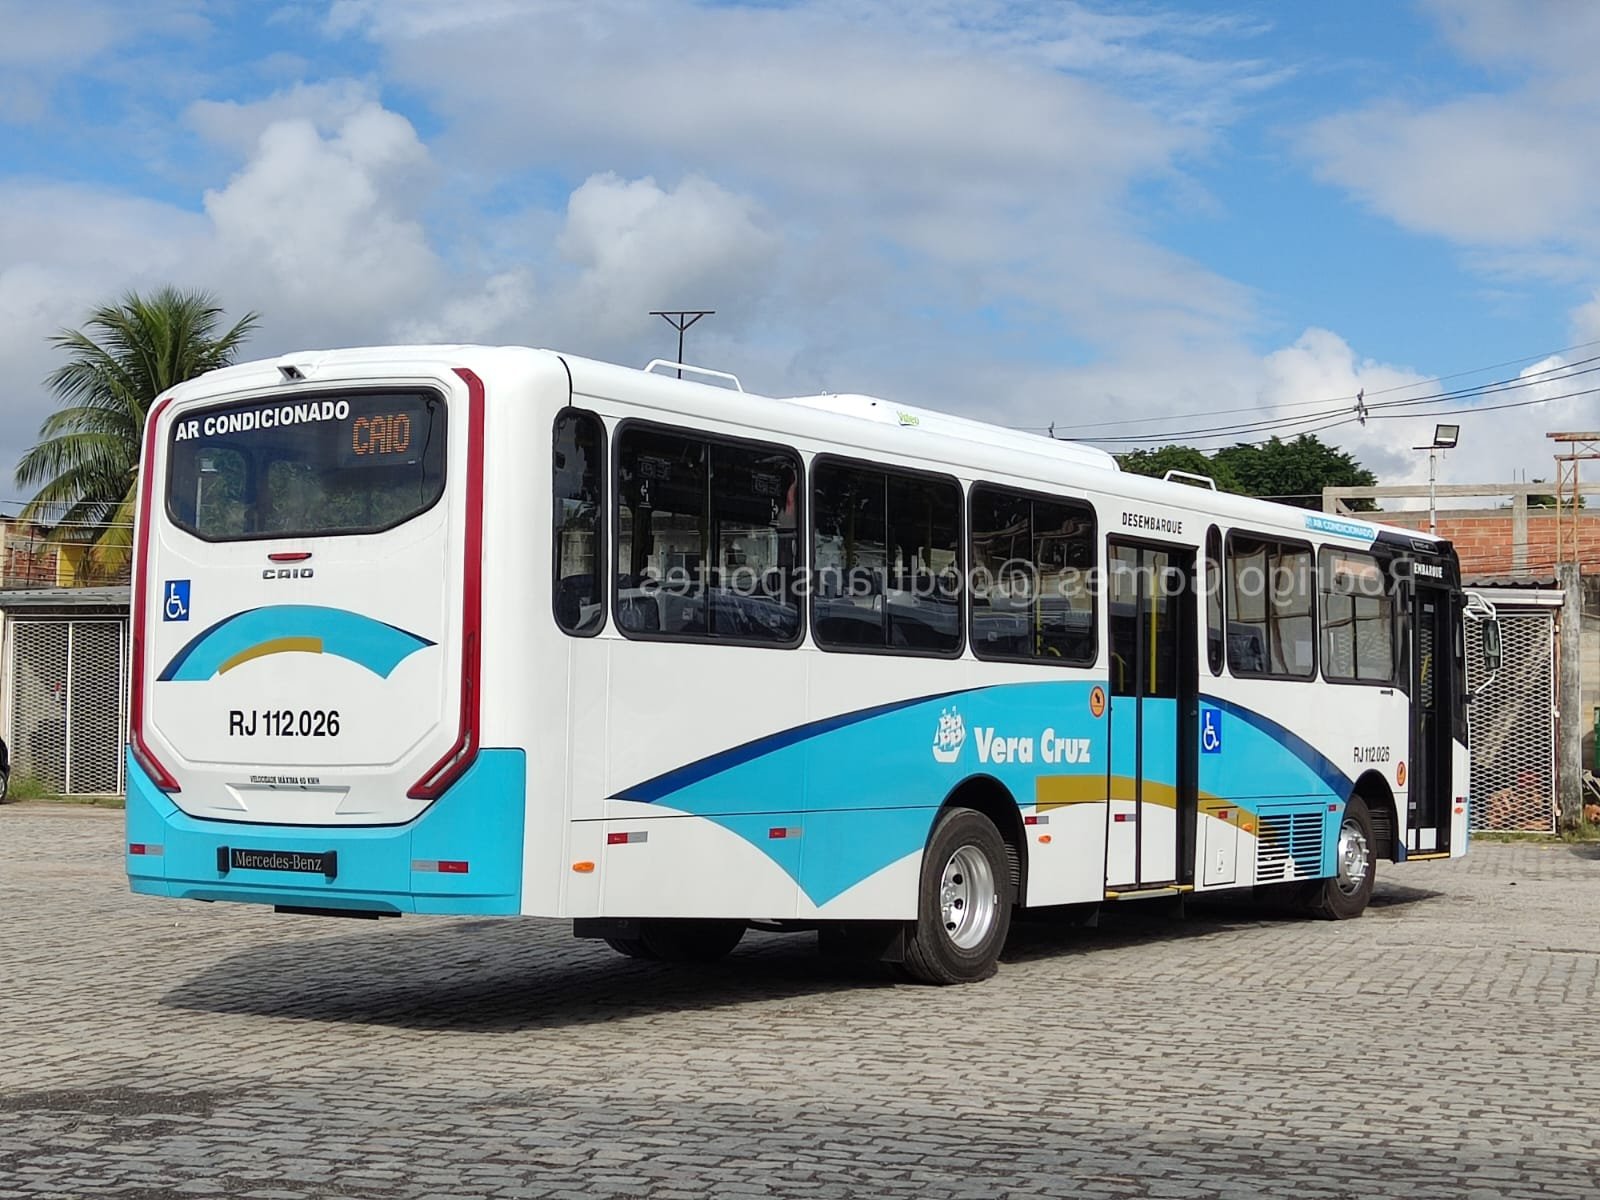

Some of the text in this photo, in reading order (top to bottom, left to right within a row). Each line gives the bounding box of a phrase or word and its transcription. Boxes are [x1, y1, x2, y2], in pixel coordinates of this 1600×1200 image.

[175, 400, 350, 442] AR CONDICIONADO
[352, 413, 411, 455] CAIO
[1122, 511, 1183, 535] DESEMBARQUE
[1323, 520, 1373, 537] CONDICIONADO
[262, 568, 314, 580] CAIO
[1413, 562, 1443, 579] EMBARQUE
[229, 710, 340, 736] RJ 112.026
[973, 727, 1091, 763] Vera Cruz
[1353, 746, 1364, 763] RJ
[235, 851, 323, 871] Mercedes-Benz
